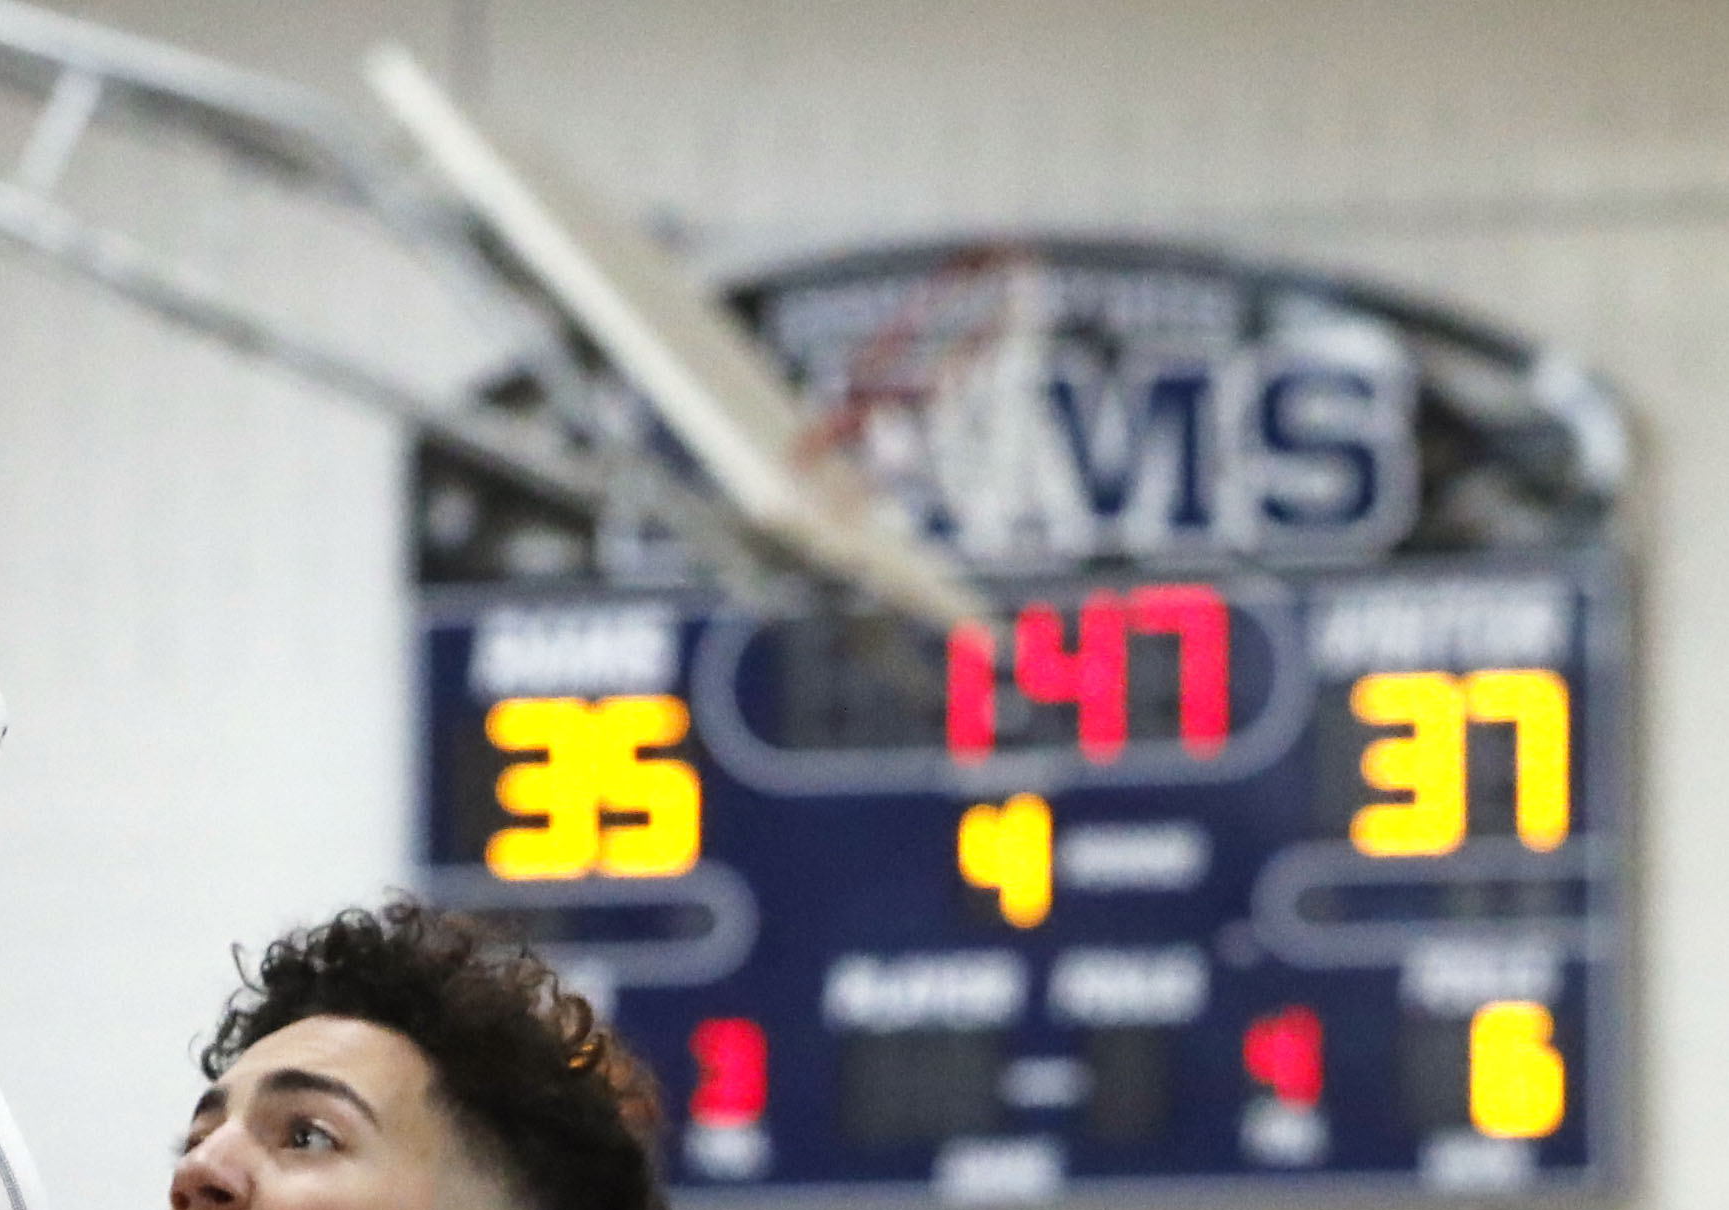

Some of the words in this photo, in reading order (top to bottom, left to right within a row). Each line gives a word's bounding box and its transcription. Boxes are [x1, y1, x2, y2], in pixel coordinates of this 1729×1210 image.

[484, 694, 704, 882] 35
[1349, 667, 1571, 858] 37
[957, 796, 1054, 929] 4
[1468, 998, 1566, 1138] 6
